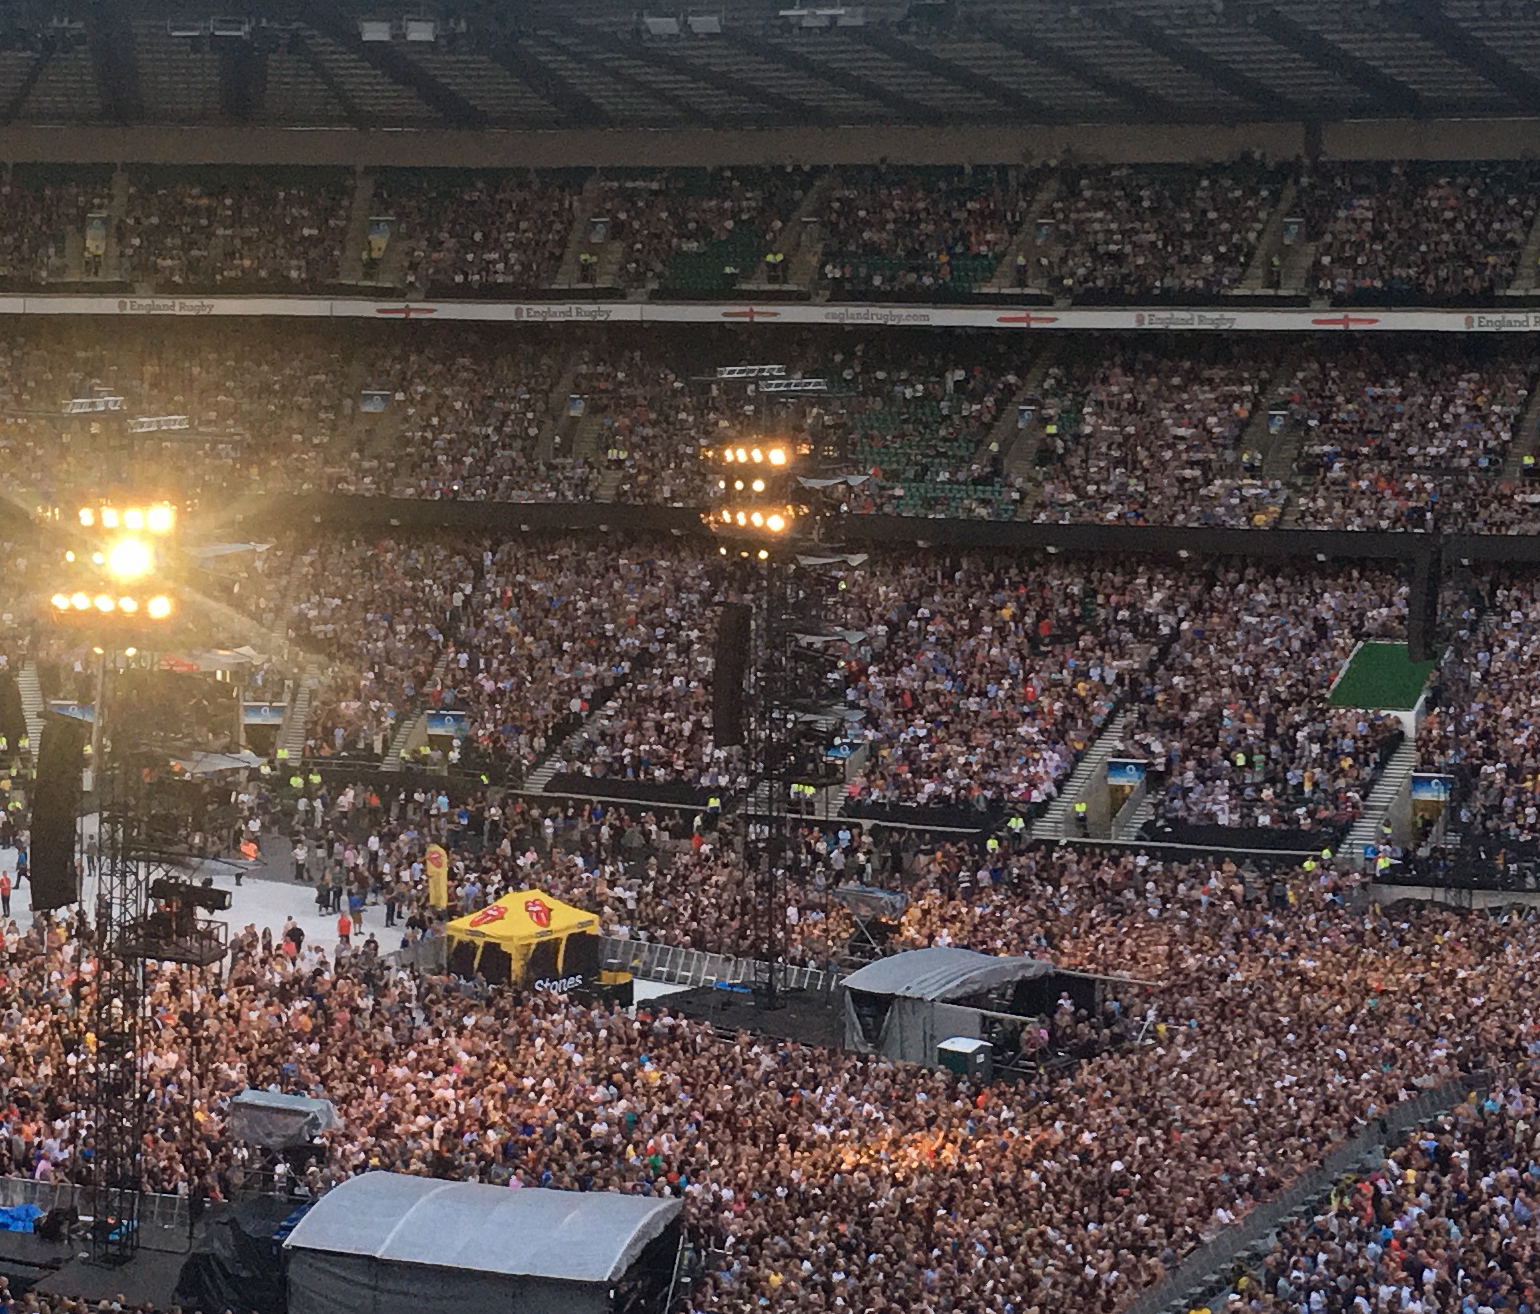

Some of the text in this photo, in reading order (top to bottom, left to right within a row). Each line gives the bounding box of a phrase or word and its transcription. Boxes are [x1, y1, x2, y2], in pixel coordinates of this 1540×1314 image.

[129, 300, 175, 314] England
[526, 306, 612, 320] England Rugby
[1477, 315, 1530, 330] England
[534, 974, 583, 994] Stones
